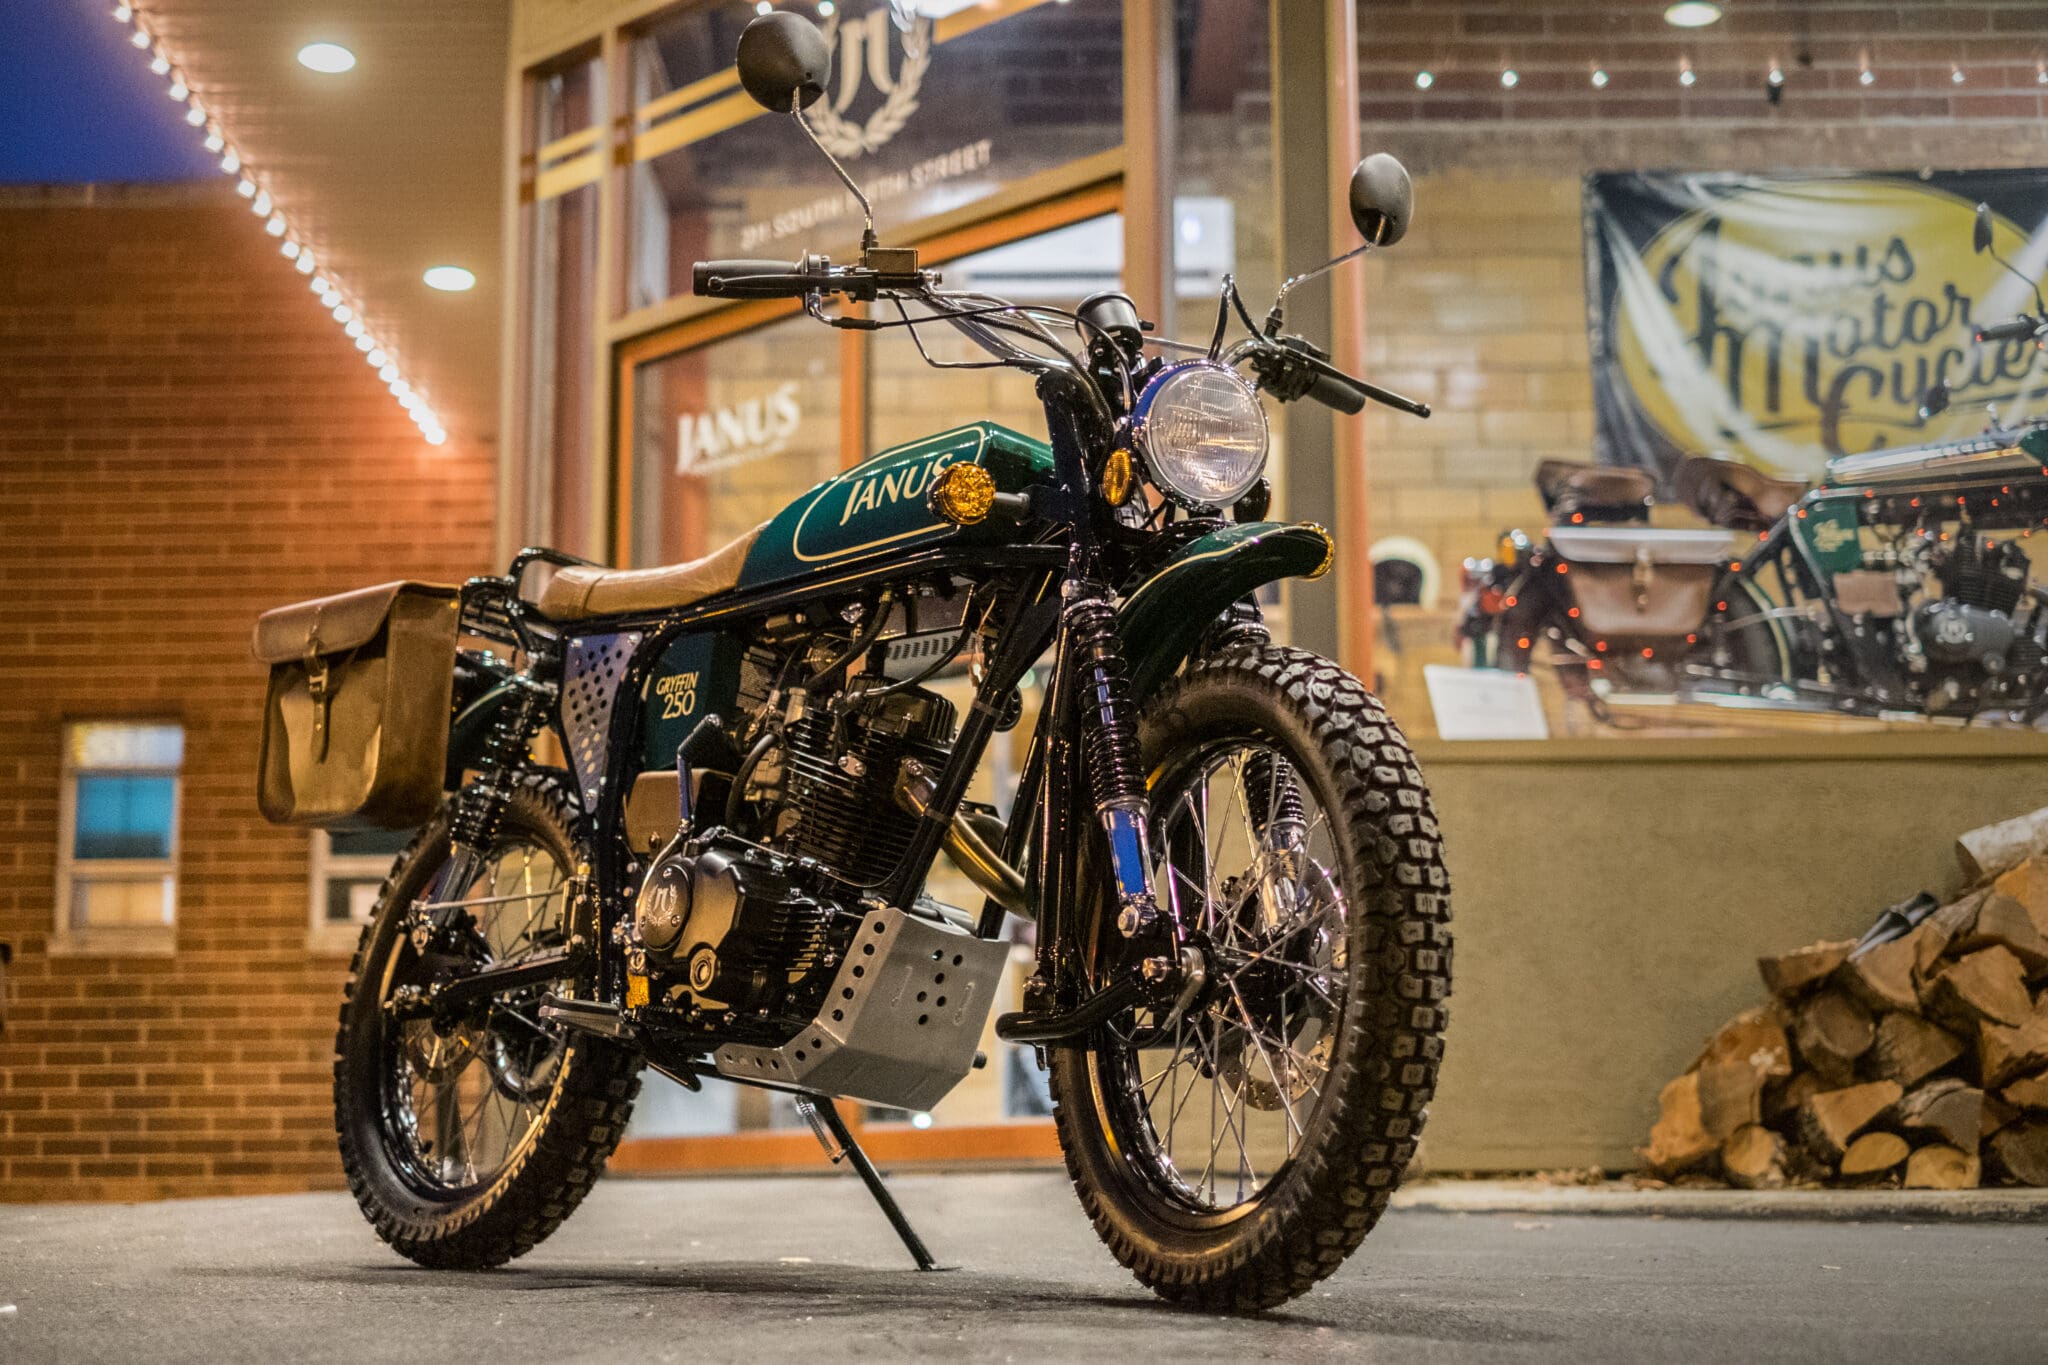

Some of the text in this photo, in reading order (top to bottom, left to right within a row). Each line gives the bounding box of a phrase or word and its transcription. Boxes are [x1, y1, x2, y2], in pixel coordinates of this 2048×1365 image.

[912, 138, 993, 187] STREET
[1819, 325, 2048, 455] Cycle
[677, 381, 800, 476] JANUS
[656, 671, 699, 695] GRYFFIN
[661, 689, 695, 720] 250
